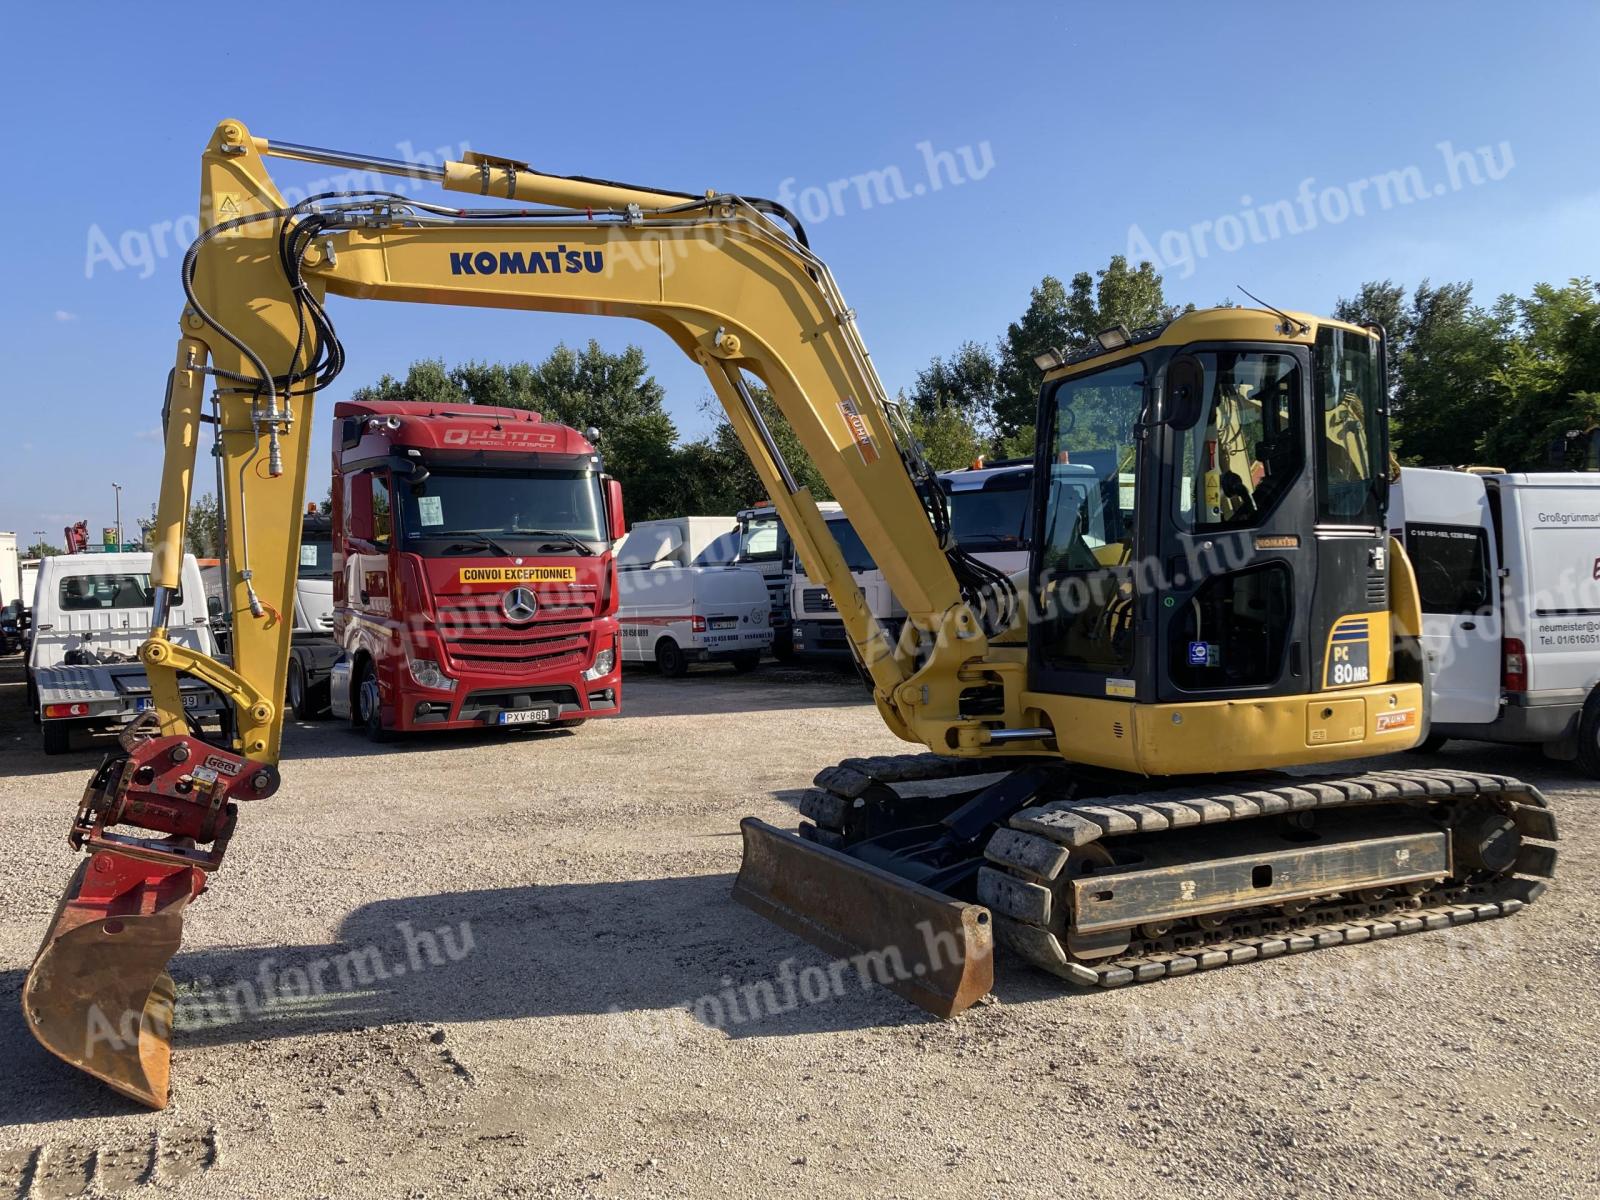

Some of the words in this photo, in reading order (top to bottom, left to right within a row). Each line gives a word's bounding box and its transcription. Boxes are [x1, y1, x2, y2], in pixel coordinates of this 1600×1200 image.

[450, 244, 604, 275] KOMATSU
[1538, 512, 1600, 524] Großgrünmar
[1255, 536, 1298, 548] KOMATSU
[464, 569, 501, 580] CONVOI
[505, 568, 573, 580] EXCEPTIONNEL
[1539, 621, 1600, 633] neumeister@o
[1539, 636, 1555, 645] Tel.
[1334, 646, 1349, 661] PC
[1334, 664, 1368, 683] 80MR
[507, 710, 547, 722] PXV-869
